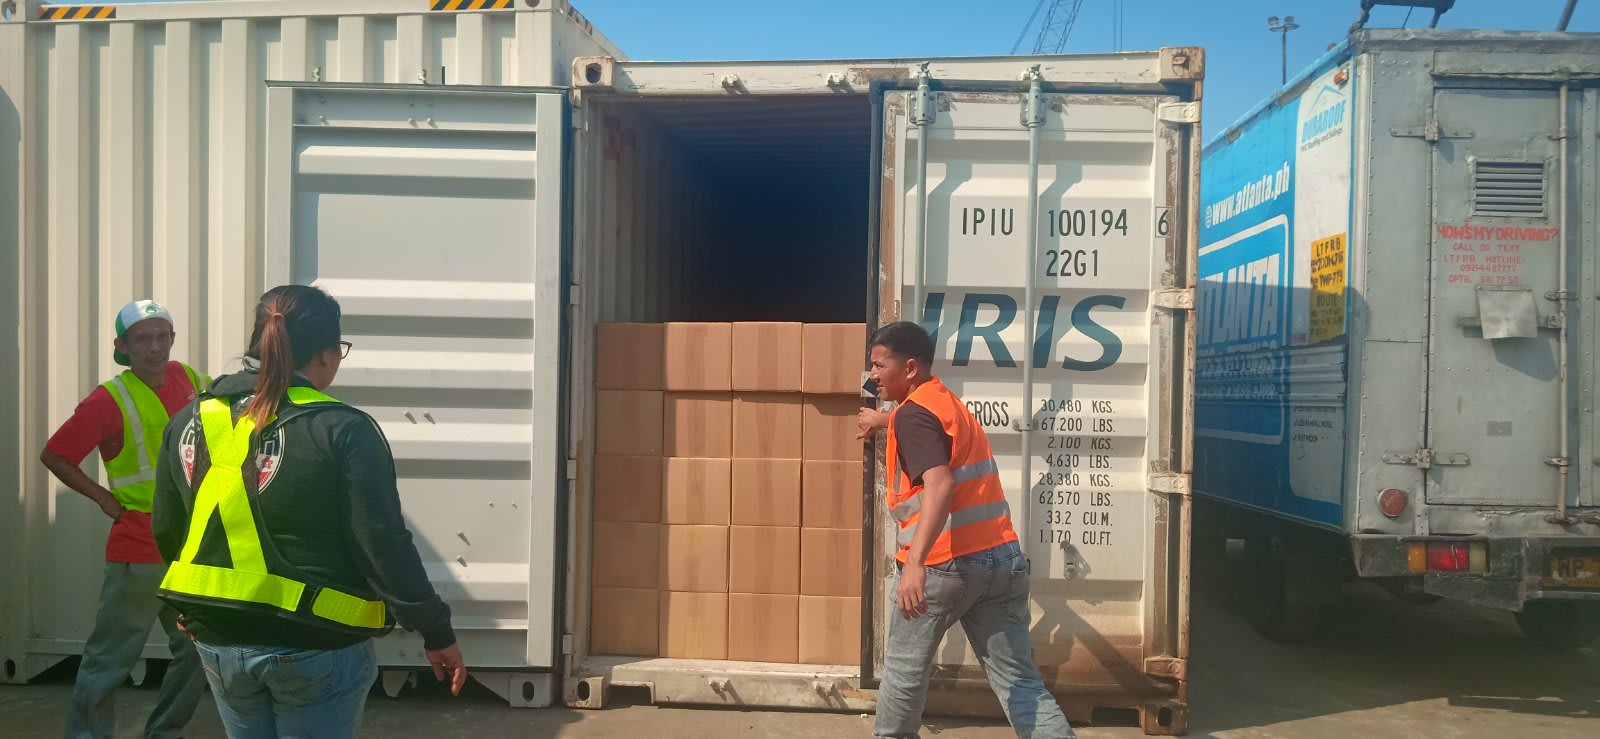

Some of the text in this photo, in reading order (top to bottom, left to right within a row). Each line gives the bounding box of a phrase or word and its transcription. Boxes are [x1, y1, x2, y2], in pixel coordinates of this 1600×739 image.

[1212, 160, 1290, 224] www.atlanta.ph
[962, 207, 1170, 237] IPIU 100194 6
[1474, 226, 1495, 241] MY
[1452, 242, 1521, 253] CALL OR TEXT
[1045, 249, 1099, 277] 22G1
[1444, 254, 1476, 263] LTFRB
[922, 292, 1127, 372] IRIS
[1040, 399, 1082, 413] 30.480
[1092, 400, 1116, 414] KGS.
[1041, 417, 1116, 433] 67.200 LBS.
[1047, 436, 1114, 450] 2.100 KGS.
[1046, 453, 1113, 469] 4.630 LBS.
[1038, 472, 1114, 488] 28.380 KGS.
[1039, 491, 1114, 507] 62.570 LBS.
[1046, 510, 1113, 526] 33.2 CU.M.
[1082, 531, 1112, 546] CU.FT.
